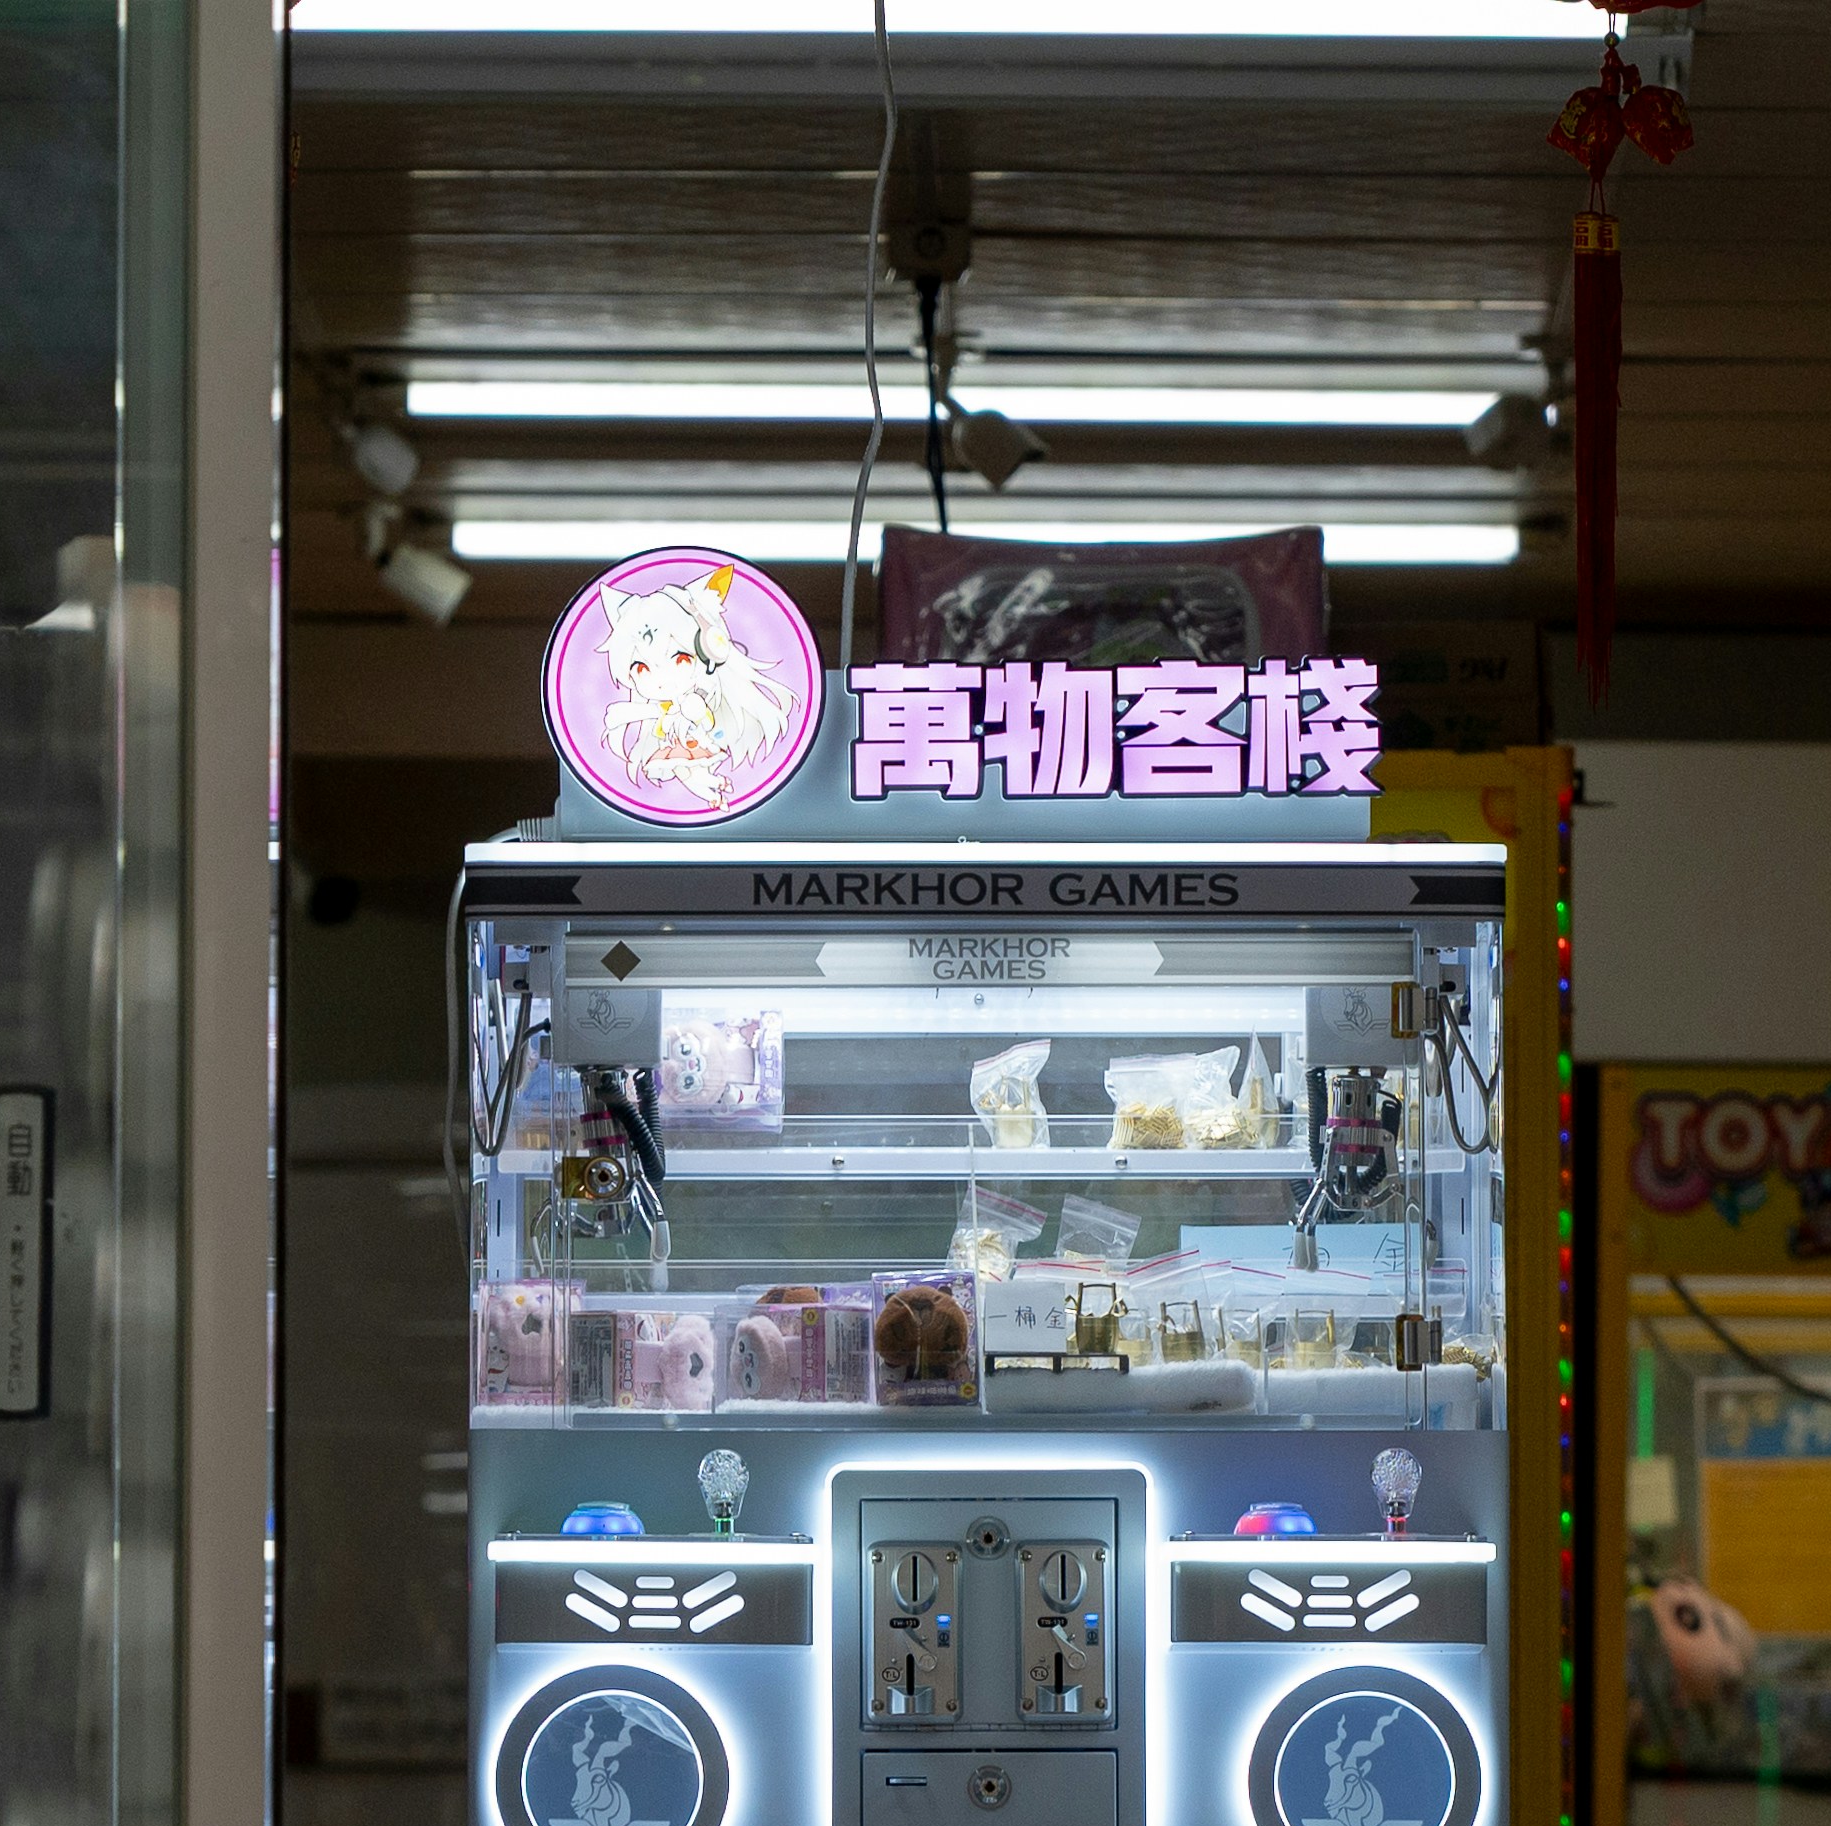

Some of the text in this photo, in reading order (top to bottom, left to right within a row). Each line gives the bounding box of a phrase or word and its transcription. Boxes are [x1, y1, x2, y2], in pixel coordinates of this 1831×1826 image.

[847, 659, 1382, 799] 萬物客棧
[752, 872, 1240, 907] MARKHOR GAMES
[908, 937, 1071, 959] MARKHOR
[932, 959, 1047, 981] GAMES
[1644, 1097, 1828, 1173] TOY
